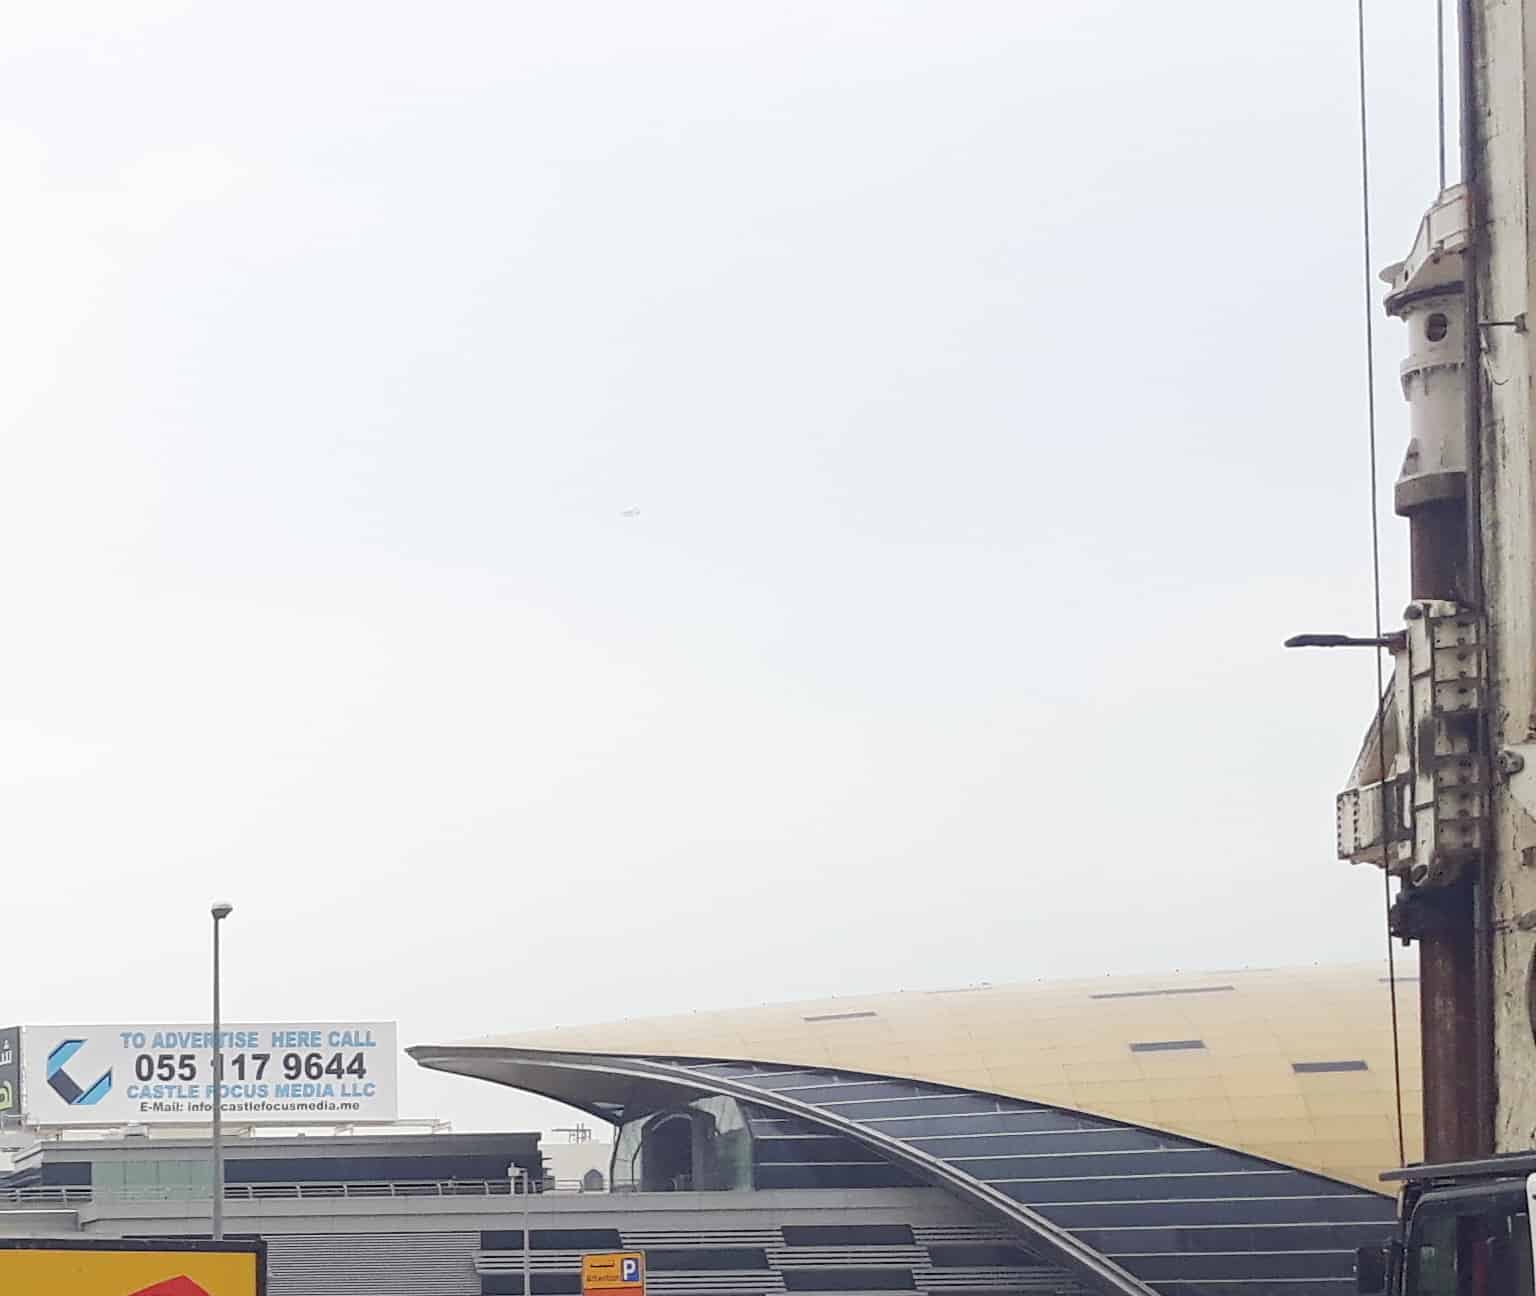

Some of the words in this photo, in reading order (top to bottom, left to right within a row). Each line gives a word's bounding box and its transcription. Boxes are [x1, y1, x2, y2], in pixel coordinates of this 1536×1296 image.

[120, 1032, 146, 1049] TO
[152, 1032, 259, 1049] ADVERTISE
[271, 1031, 322, 1048] HERE
[329, 1030, 377, 1047] CALL
[135, 1054, 197, 1082] 055
[210, 1053, 271, 1081] 117
[283, 1052, 366, 1081] 9644
[127, 1085, 200, 1099] CASTLE
[207, 1084, 269, 1098] FOCUS
[275, 1083, 334, 1098] MEDIA
[341, 1082, 376, 1097] LLC
[140, 1102, 183, 1112] E-Mail:
[187, 1100, 360, 1112] infocastlefocusmedia.me
[623, 1259, 636, 1280] P
